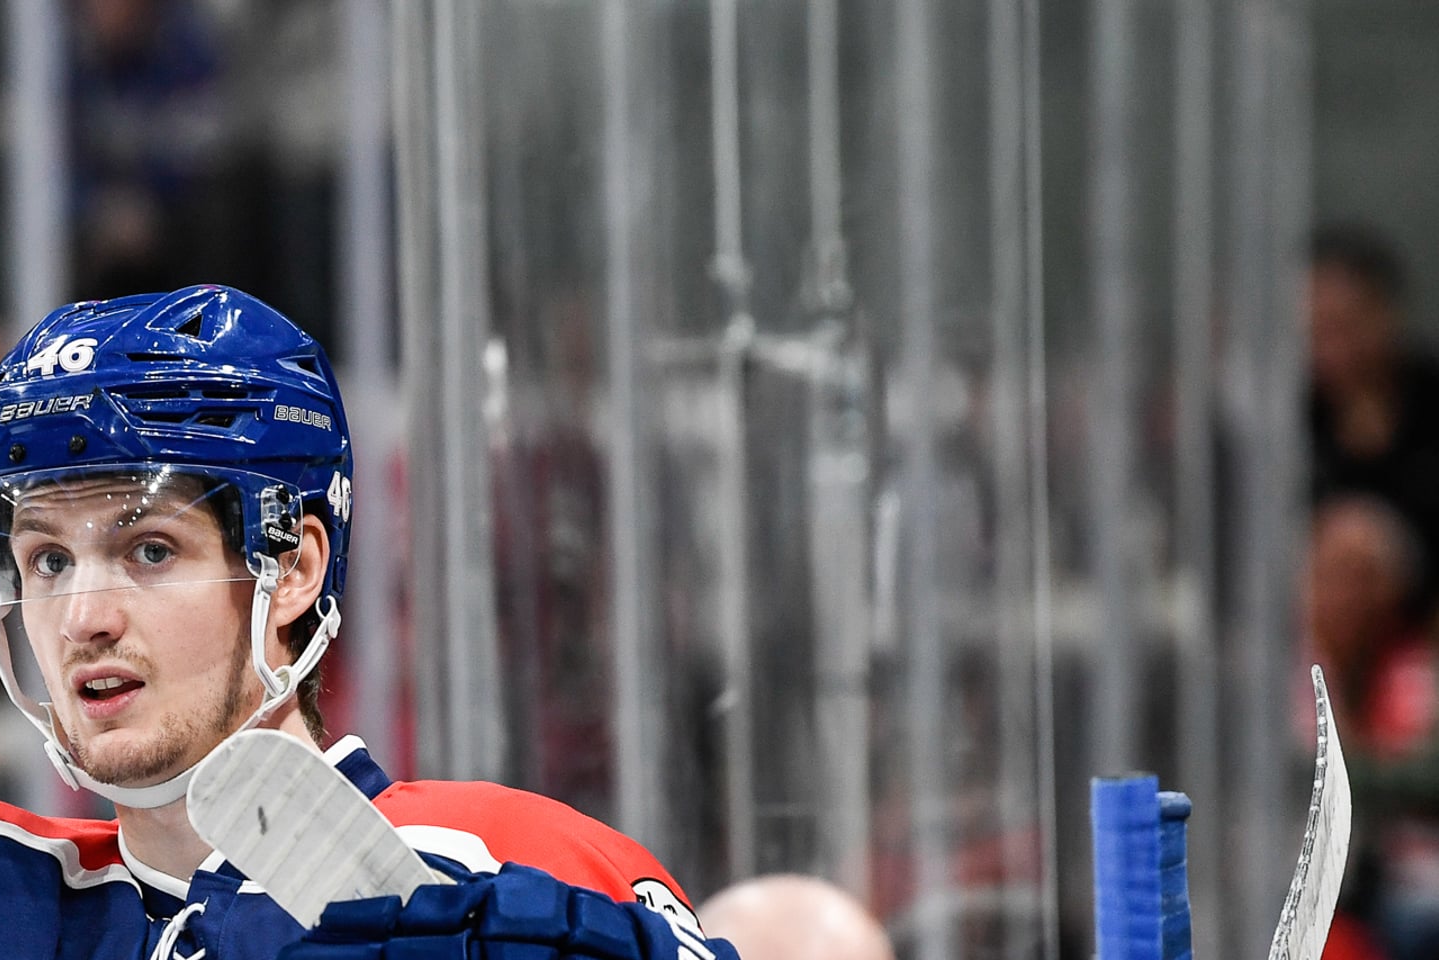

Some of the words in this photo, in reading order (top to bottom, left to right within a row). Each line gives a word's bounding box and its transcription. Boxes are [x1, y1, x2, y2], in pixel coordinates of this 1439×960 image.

[27, 334, 98, 376] 46
[273, 404, 332, 432] BAUER
[267, 526, 299, 545] BAUER
